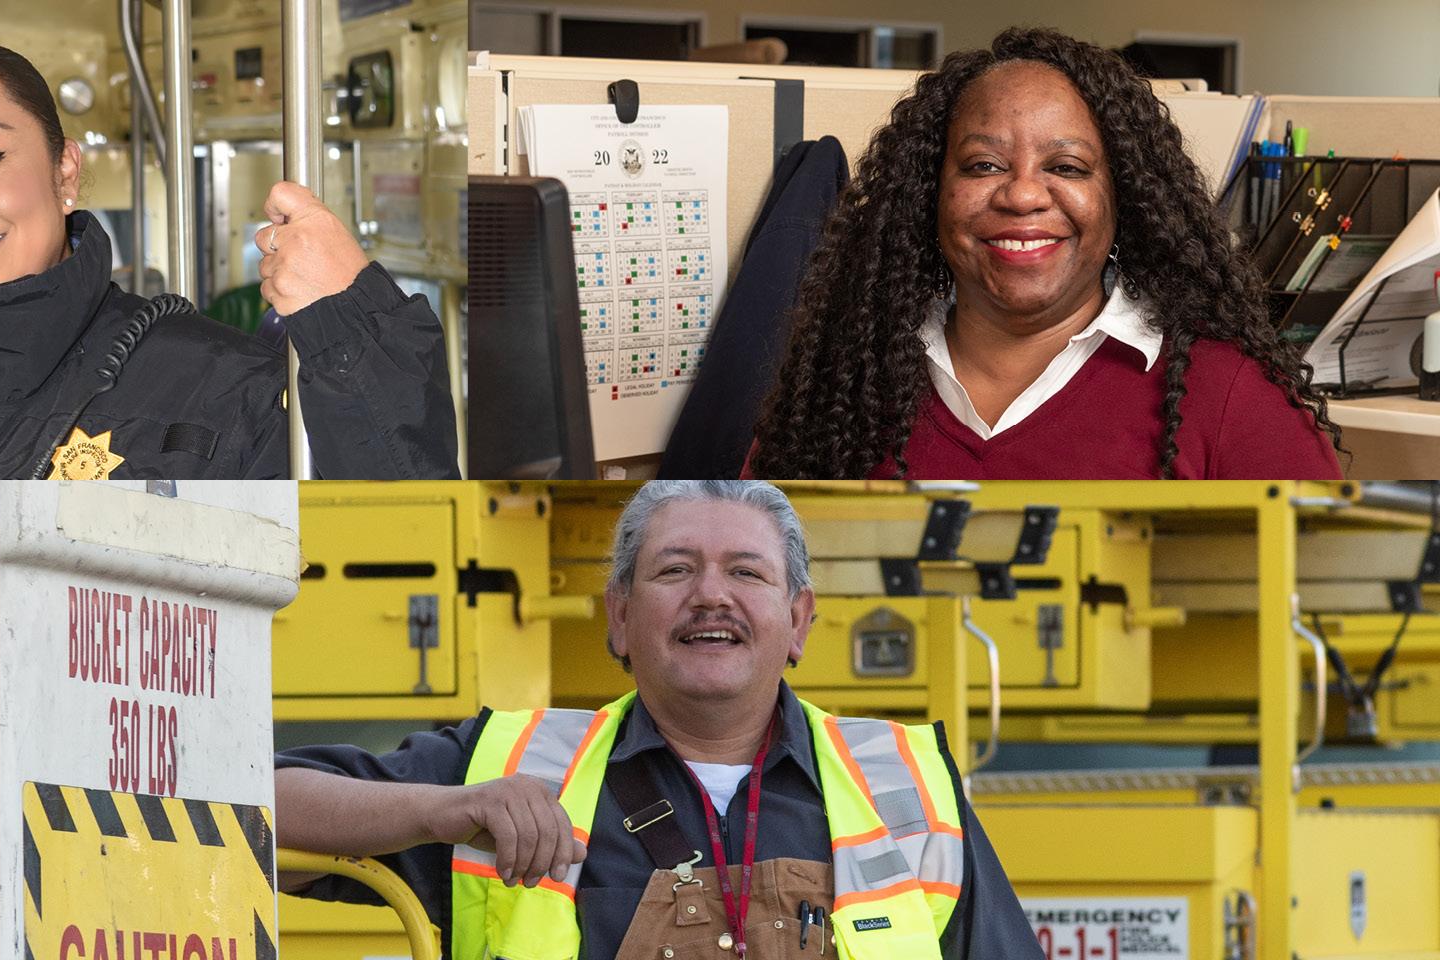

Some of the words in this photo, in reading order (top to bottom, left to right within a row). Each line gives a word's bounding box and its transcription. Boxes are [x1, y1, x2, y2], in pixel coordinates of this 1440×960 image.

[594, 150, 611, 166] 20
[652, 149, 669, 164] 22
[63, 445, 76, 460] SAN
[77, 443, 108, 463] FRANCISCO
[80, 461, 87, 469] 5
[68, 585, 133, 686] BUCKET
[139, 596, 218, 698] CAPACITY
[108, 696, 140, 794] 350
[148, 703, 178, 798] LBS
